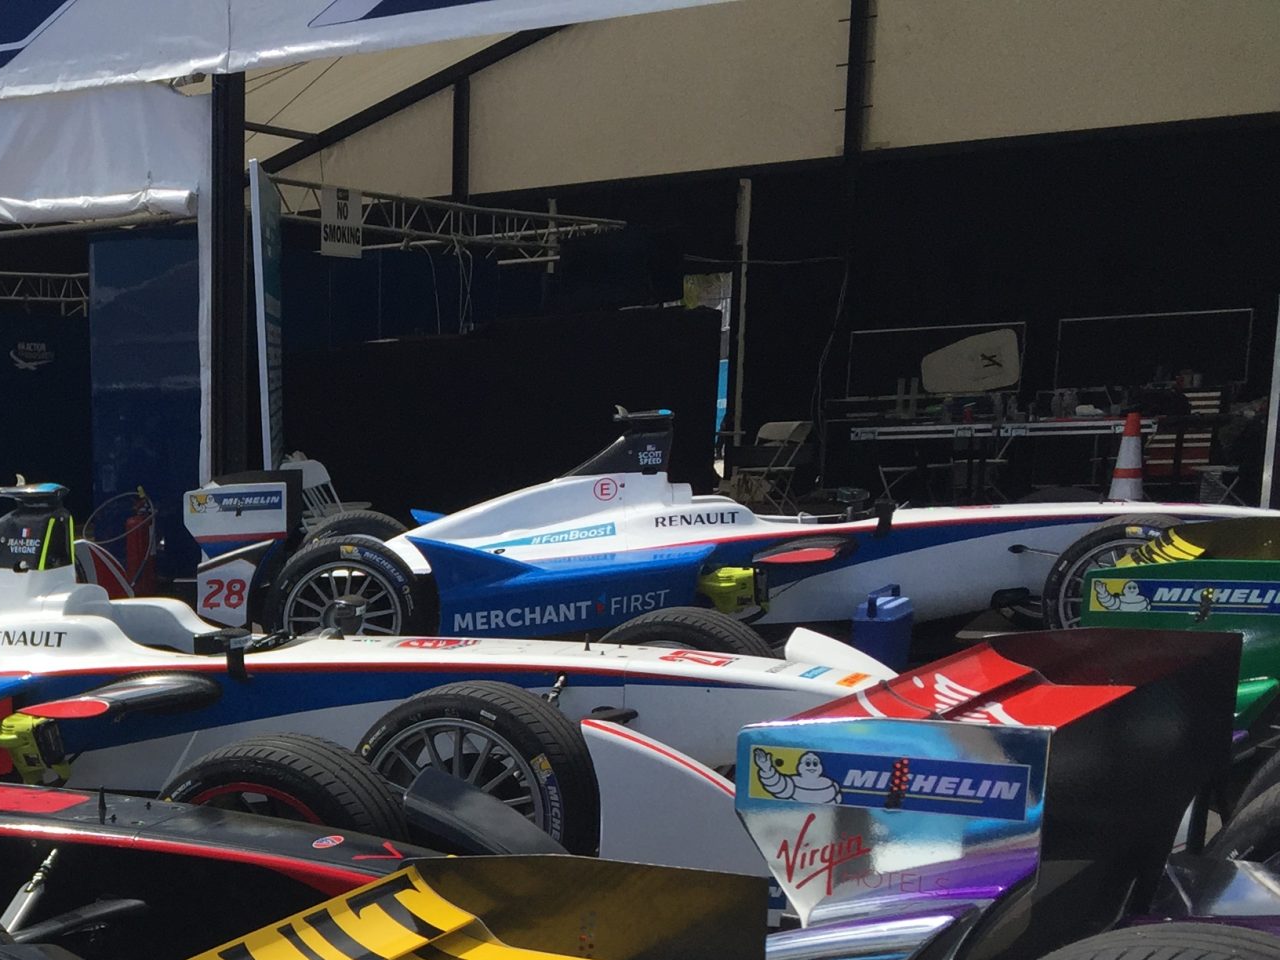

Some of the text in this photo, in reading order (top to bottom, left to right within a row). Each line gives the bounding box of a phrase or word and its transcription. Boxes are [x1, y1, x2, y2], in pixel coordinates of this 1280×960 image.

[337, 201, 349, 220] NO
[323, 224, 361, 245] SMOKING
[638, 451, 662, 459] SCOTT
[640, 457, 662, 465] SPEED
[222, 495, 280, 506] MICHELIN
[654, 510, 740, 528] RENAULT
[531, 523, 614, 545] #FanBoost
[202, 578, 246, 609] 28
[454, 590, 670, 632] MERCHANT FIRST
[843, 769, 1021, 800] MIHELIN
[776, 813, 871, 896] Virgin
